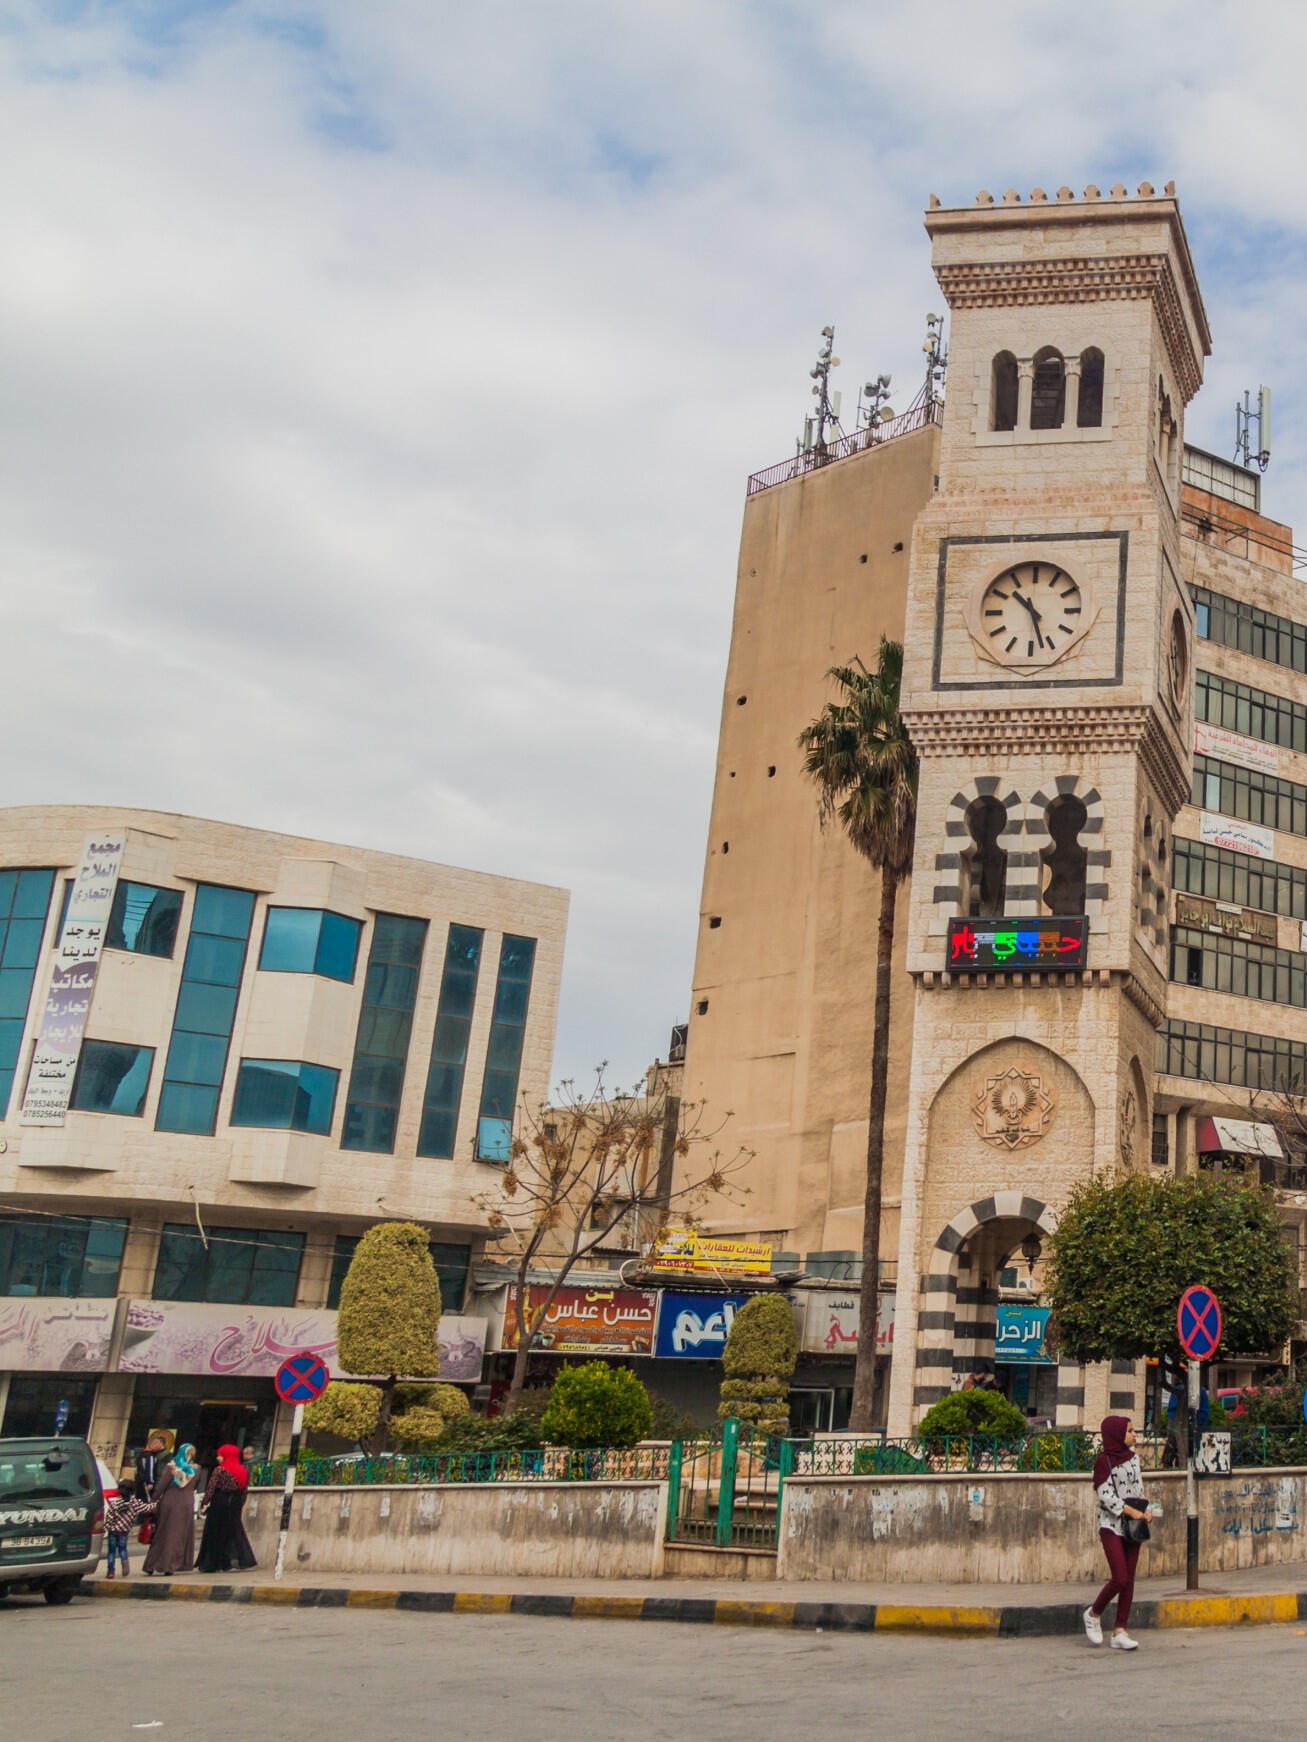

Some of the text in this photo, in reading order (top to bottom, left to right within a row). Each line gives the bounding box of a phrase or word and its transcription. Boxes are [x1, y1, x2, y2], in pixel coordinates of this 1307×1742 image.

[51, 973, 94, 993] مكاتب
[45, 998, 89, 1017] تجارية
[545, 1299, 652, 1326] حسن عباس
[0, 1507, 89, 1525] YUNDAI
